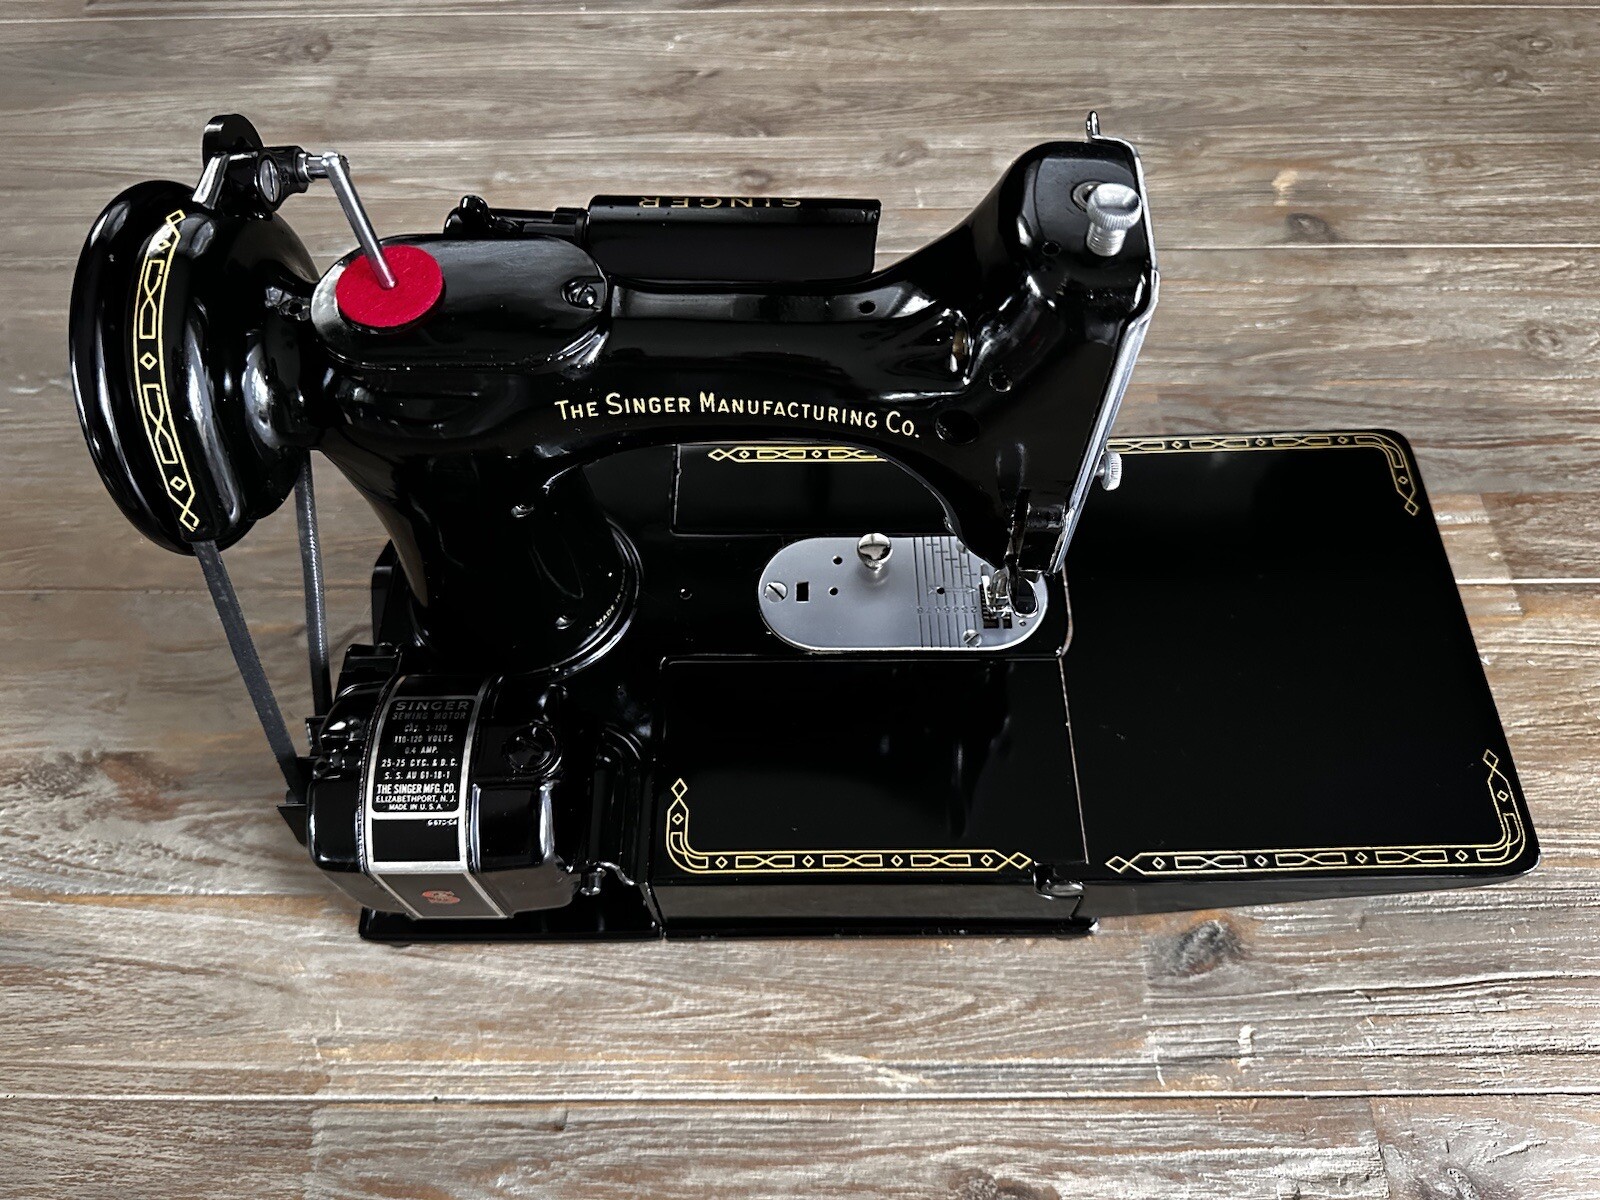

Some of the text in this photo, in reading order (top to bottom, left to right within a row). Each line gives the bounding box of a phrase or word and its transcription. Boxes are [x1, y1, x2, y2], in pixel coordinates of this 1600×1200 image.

[639, 197, 801, 208] SINGER
[554, 391, 920, 438] THE SINGER MANUFACTURING CO.
[395, 701, 469, 711] SINGER
[391, 711, 467, 720] SEWING MOTOR
[427, 734, 454, 743] VOLTS
[420, 745, 439, 754] AMP.
[381, 758, 406, 767] 25-75
[409, 758, 430, 767] CYC.
[406, 771, 418, 780] AU
[377, 783, 457, 795] THE SINGER MFG. CO.
[375, 794, 439, 804] ELIZABETHPORT,
[440, 794, 449, 803] N.
[388, 803, 408, 811] MADE
[409, 803, 418, 811] IN
